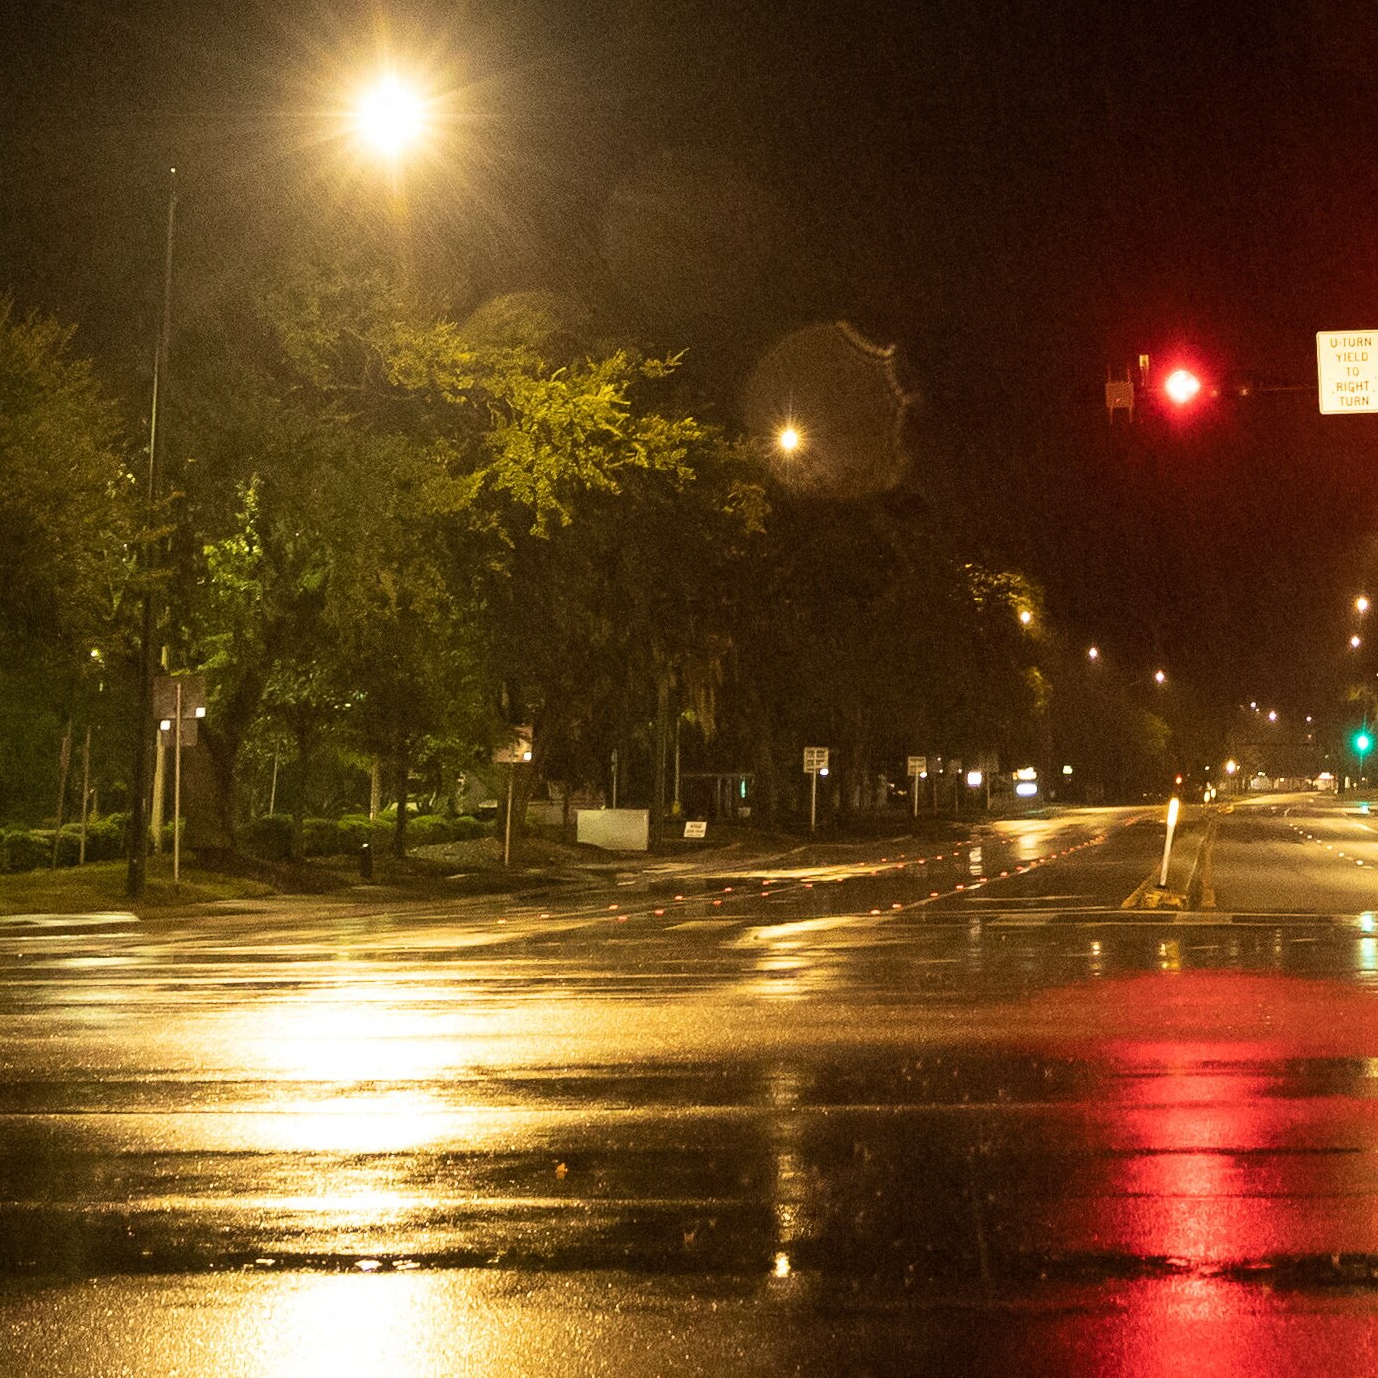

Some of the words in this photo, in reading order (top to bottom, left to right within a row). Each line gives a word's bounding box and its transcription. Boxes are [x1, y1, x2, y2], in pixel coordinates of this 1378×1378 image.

[1330, 337, 1372, 349] U-TURN
[1335, 352, 1369, 363] YIELD
[1346, 366, 1360, 377] TO
[1336, 380, 1370, 392] RIGHT
[1339, 396, 1370, 407] TURN
